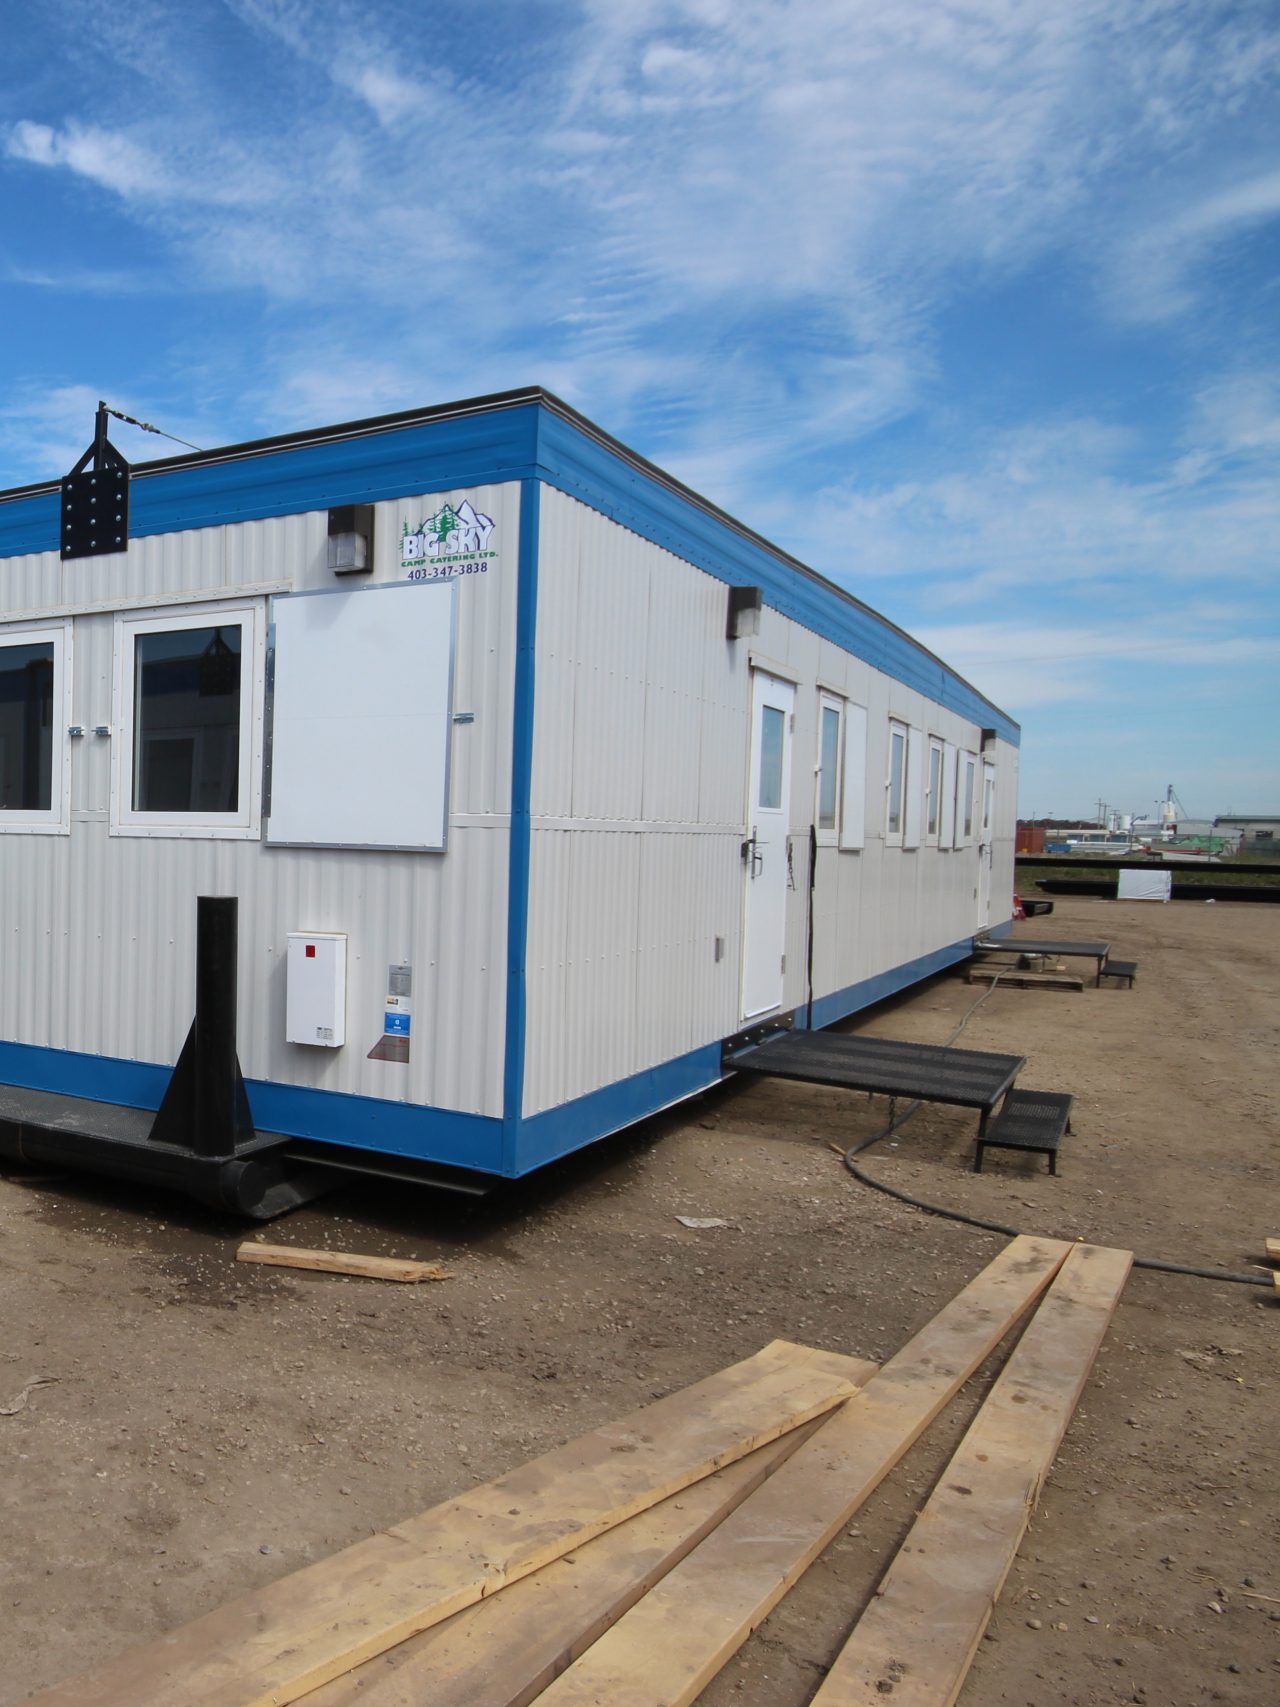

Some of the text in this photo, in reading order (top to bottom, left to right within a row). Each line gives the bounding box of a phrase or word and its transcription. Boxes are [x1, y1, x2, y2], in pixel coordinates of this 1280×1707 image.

[402, 526, 494, 560] BIG SKY
[401, 551, 499, 567] CAMP CATERING LTD.
[408, 562, 487, 580] 403-347-3838
